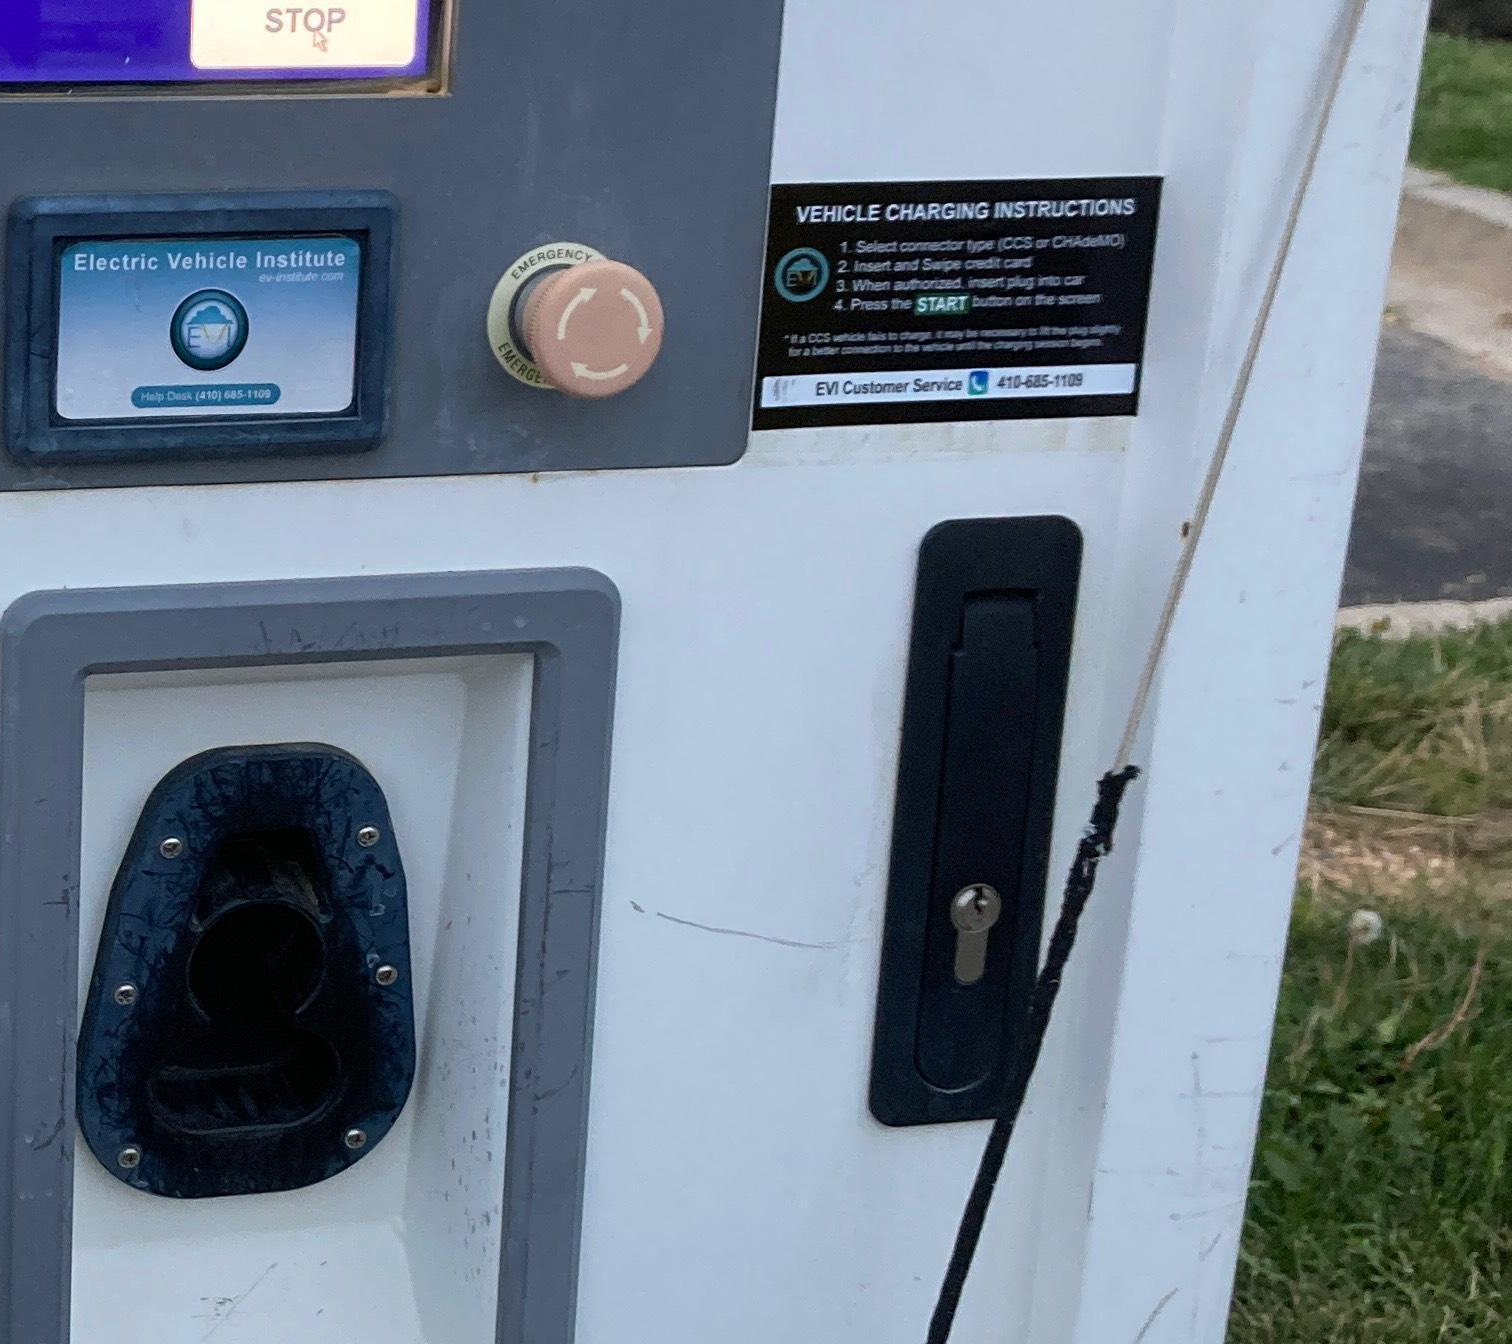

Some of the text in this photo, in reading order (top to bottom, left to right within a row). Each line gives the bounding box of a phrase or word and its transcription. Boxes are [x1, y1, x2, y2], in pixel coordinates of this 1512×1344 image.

[264, 7, 346, 33] STOP
[796, 199, 1136, 224] VEHICLE CHARGING INSTRUCTIONS
[855, 240, 897, 253] Select
[899, 240, 965, 252] connector
[967, 240, 994, 253] type
[998, 236, 1033, 252] (CCS
[73, 249, 346, 273] Electric Vehicle Institute
[511, 247, 594, 280] EMERGENCY
[854, 260, 892, 272] Insert
[894, 258, 919, 271] and
[965, 257, 1000, 270] credit
[1003, 256, 1033, 269] card
[258, 269, 344, 284] ev-institute.com
[852, 279, 890, 291] When
[967, 276, 1004, 289] insert
[1006, 276, 1034, 290] plug
[1064, 275, 1088, 286] car
[850, 297, 887, 311] Press
[890, 297, 913, 310] the
[917, 295, 969, 312] START
[1035, 294, 1056, 306] the
[497, 341, 548, 385] EMERGE
[816, 373, 1084, 396] EVI Customer Service 410-685-1109
[140, 388, 272, 404] Help Desk (410) 685-1109
